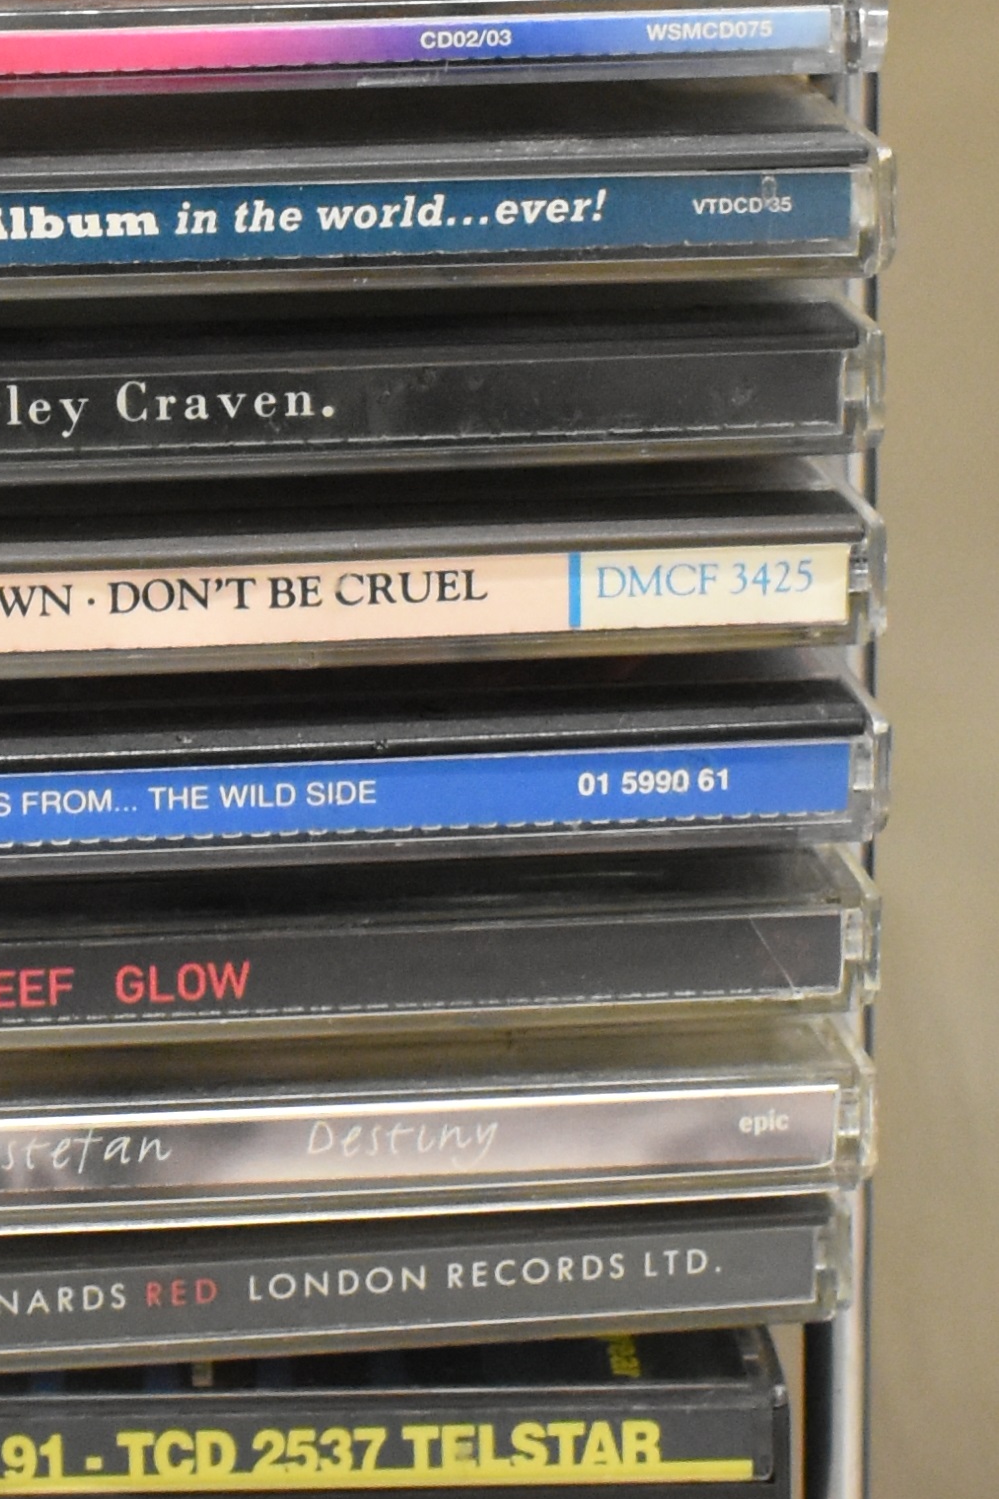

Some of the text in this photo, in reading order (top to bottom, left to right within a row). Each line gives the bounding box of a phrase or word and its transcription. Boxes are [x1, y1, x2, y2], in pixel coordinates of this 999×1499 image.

[419, 28, 513, 50] CD02/03
[646, 20, 773, 42] WSMCD075
[174, 202, 218, 235] in
[232, 199, 301, 233] the
[116, 378, 336, 422] Craven.
[109, 577, 257, 615] DON'T
[269, 573, 324, 610] BE
[334, 568, 489, 607] CRUEL
[596, 557, 814, 600] DMCF 3425
[21, 789, 139, 817] FROM...
[149, 785, 212, 811] THE
[217, 781, 297, 809] WILD
[306, 779, 378, 807] SIDE
[577, 769, 730, 797] 01 61
[114, 962, 251, 1004] GLOW
[307, 1118, 500, 1166] Destiny
[738, 1110, 790, 1136] epic
[144, 1278, 218, 1308] RED
[248, 1265, 428, 1303] LONDON
[447, 1252, 627, 1289] RECORDS
[643, 1248, 723, 1280] LTD.
[1, 1434, 64, 1480] 91
[115, 1427, 238, 1479] TCD
[251, 1425, 388, 1474] 2537
[401, 1419, 664, 1471] TELSTAR
